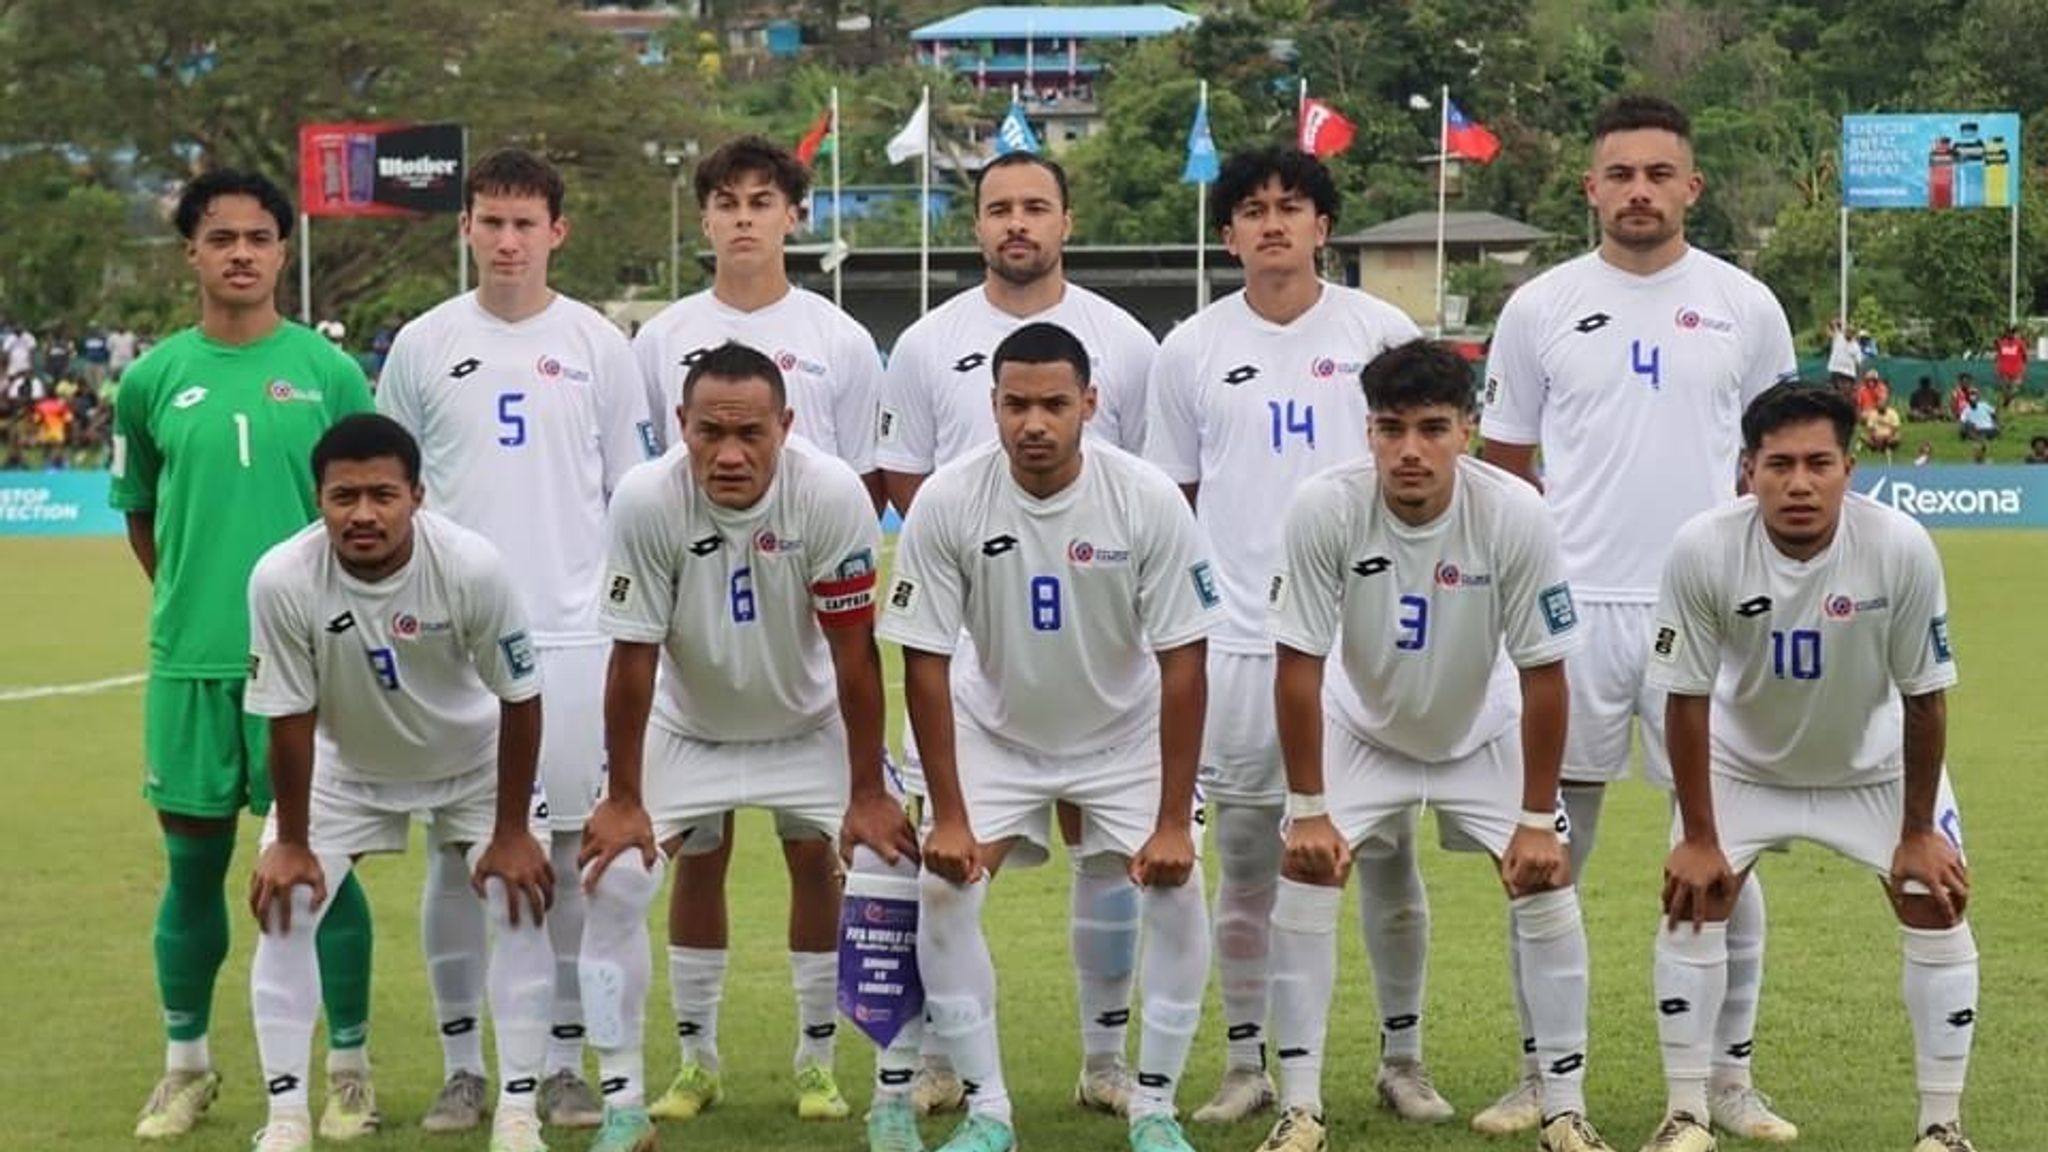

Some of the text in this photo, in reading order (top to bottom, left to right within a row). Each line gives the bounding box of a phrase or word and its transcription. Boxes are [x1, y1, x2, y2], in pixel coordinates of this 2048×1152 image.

[377, 155, 458, 177] Mother
[1631, 339, 1660, 390] 4
[232, 412, 251, 468] 1
[497, 392, 526, 447] 5
[1268, 399, 1316, 453] 14
[1891, 481, 2021, 514] Rexona
[731, 567, 756, 622] 6
[825, 592, 871, 610] CAPTAIN
[1030, 575, 1062, 632] 8
[1395, 594, 1429, 651] 3
[366, 648, 399, 691] 9
[1771, 629, 1821, 680] 10
